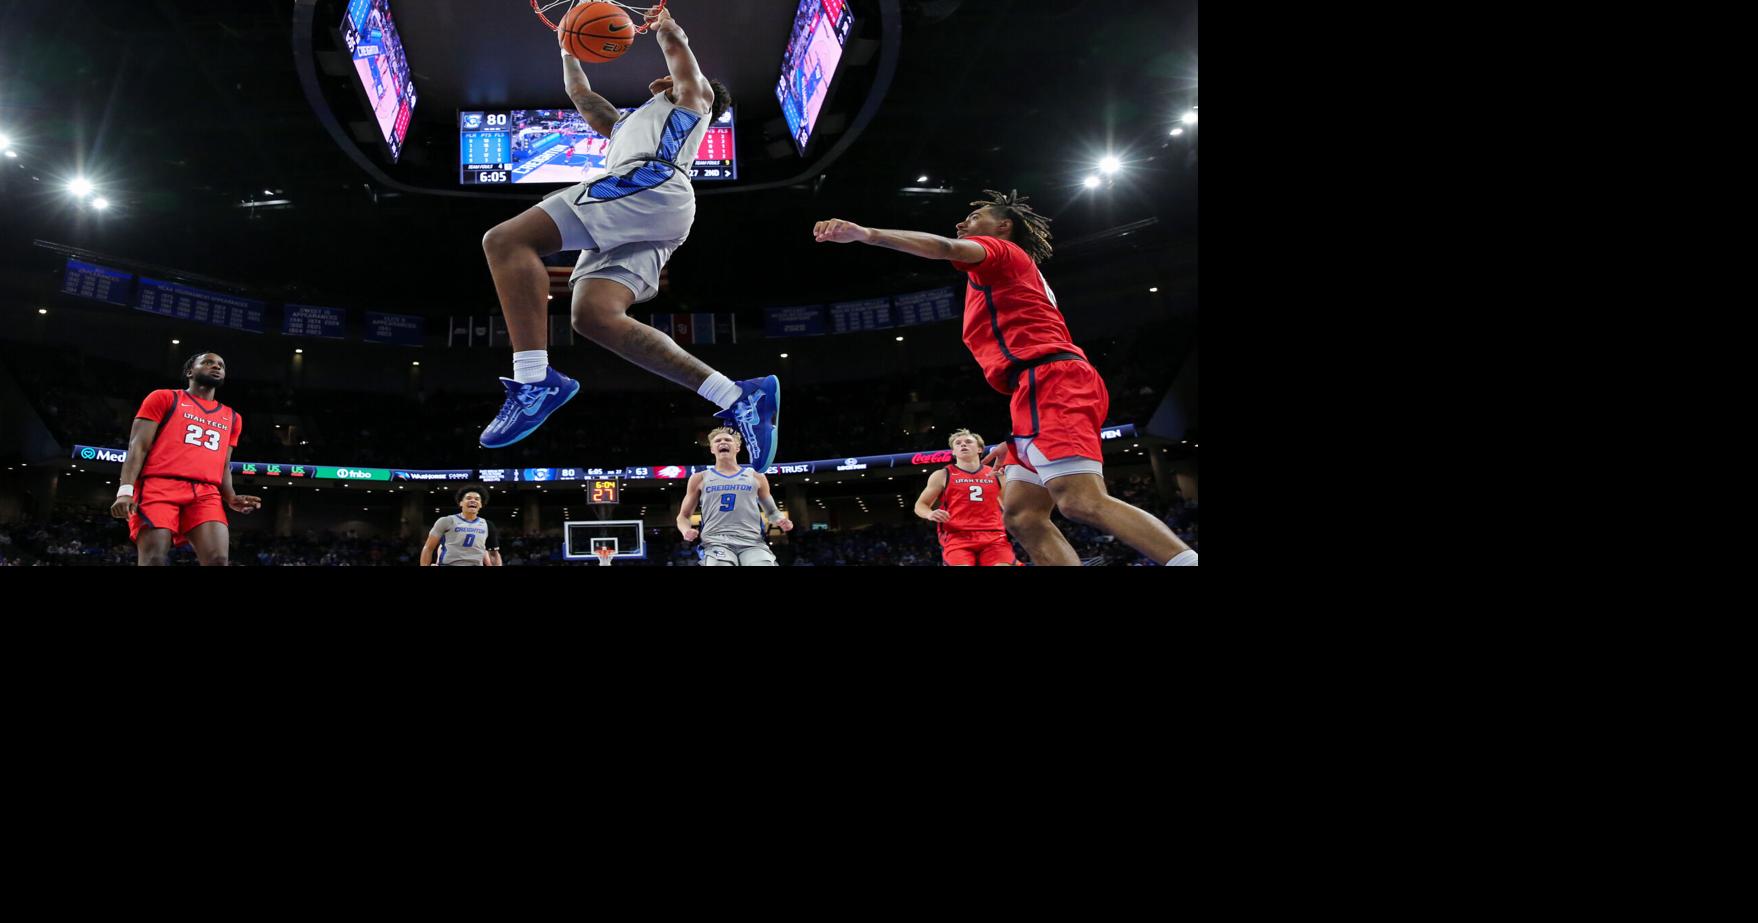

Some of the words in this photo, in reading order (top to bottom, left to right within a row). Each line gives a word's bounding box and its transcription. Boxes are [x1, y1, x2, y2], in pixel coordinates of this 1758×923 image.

[487, 114, 507, 125] 80
[479, 172, 507, 182] 6:05
[183, 412, 206, 424] UTAH
[207, 420, 228, 431] TECH
[184, 424, 221, 451] 23
[349, 470, 372, 478] fnbo
[561, 469, 575, 477] 80
[635, 467, 648, 476] 63
[595, 481, 616, 489] 6:04
[705, 484, 752, 493] CREIGHTON
[593, 488, 614, 502] 27
[968, 485, 984, 502] 2
[719, 493, 737, 512] 9
[454, 526, 486, 534] CREIGHTON
[463, 533, 476, 548] 0
